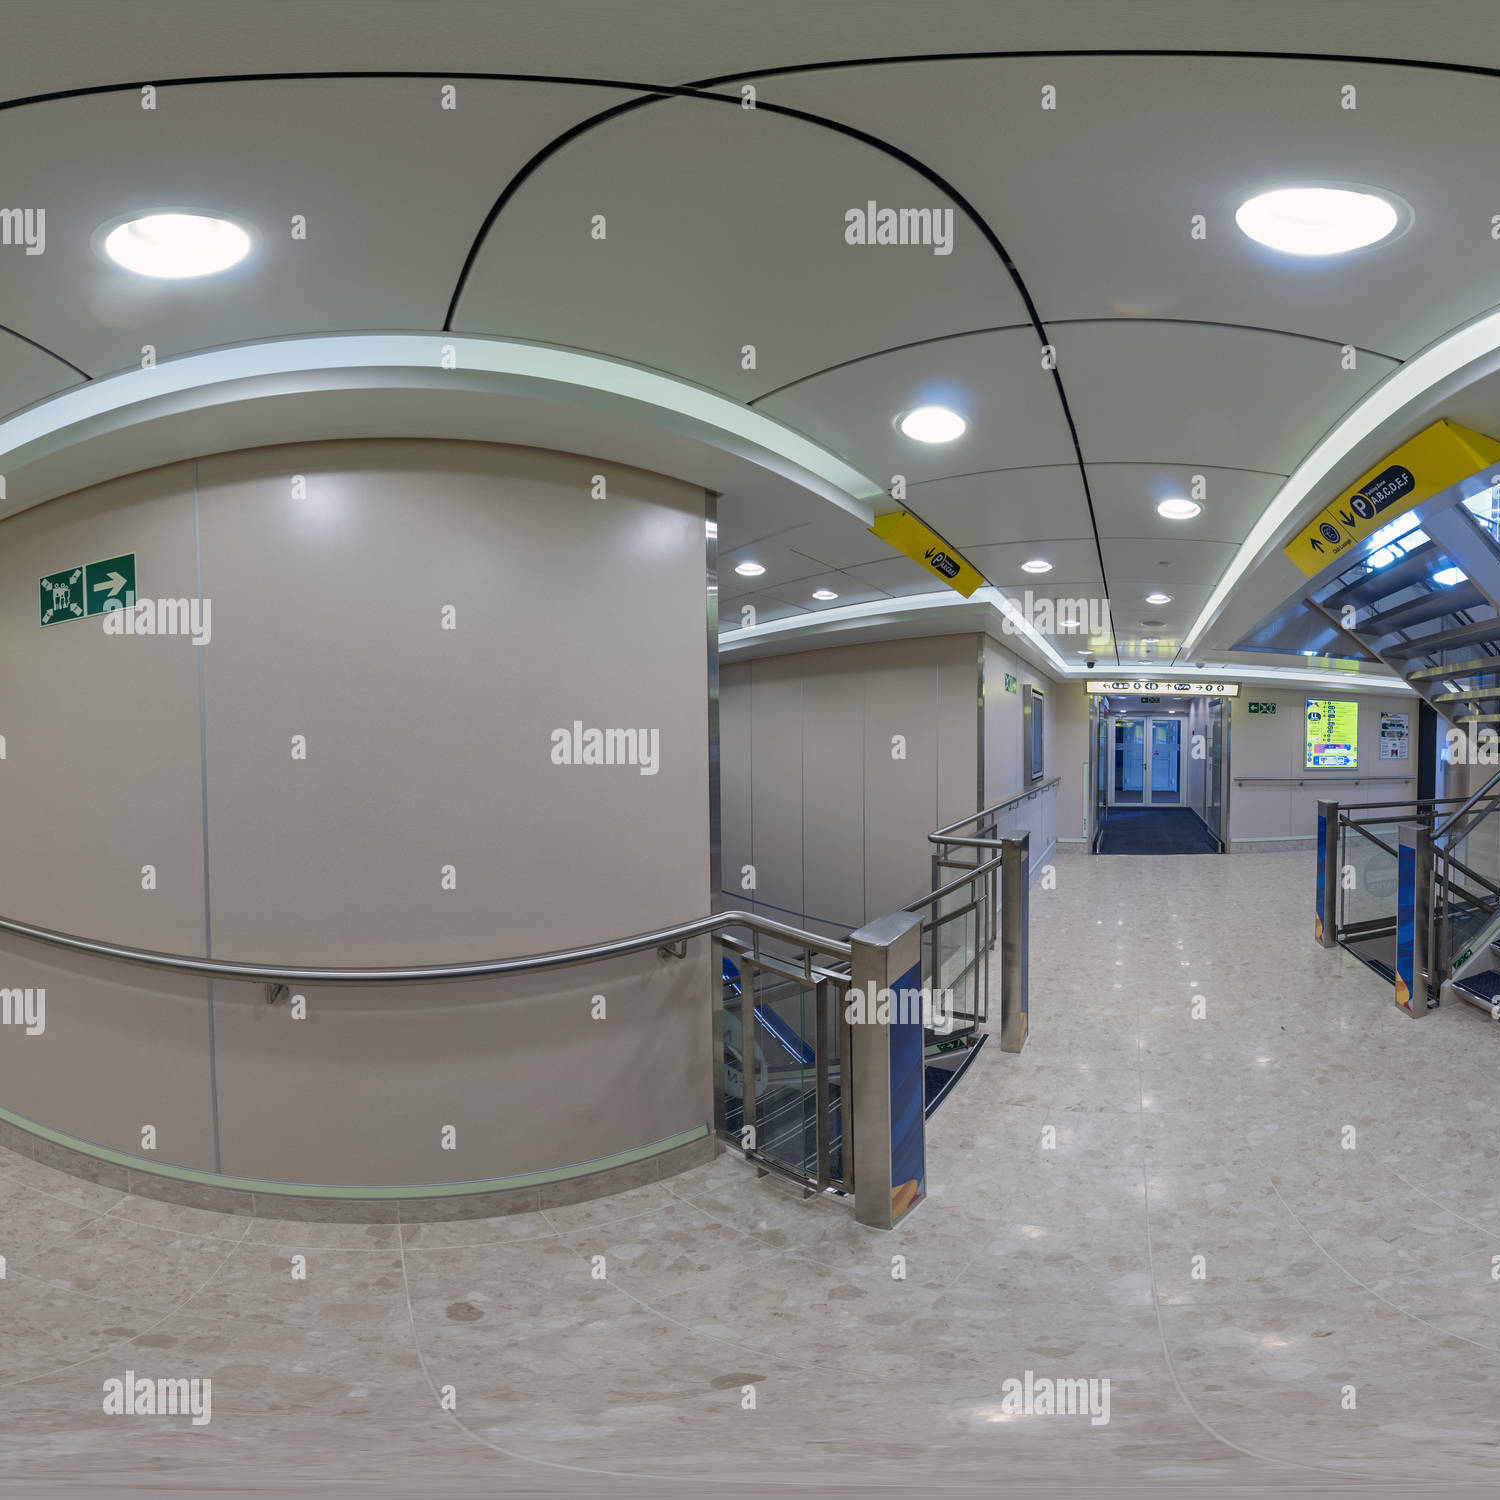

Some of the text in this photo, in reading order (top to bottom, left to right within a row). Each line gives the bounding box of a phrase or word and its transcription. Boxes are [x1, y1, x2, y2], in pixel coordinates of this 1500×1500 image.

[1370, 472, 1409, 505] A,B,C,D,E,F
[1352, 498, 1367, 517] P
[932, 554, 943, 566] P
